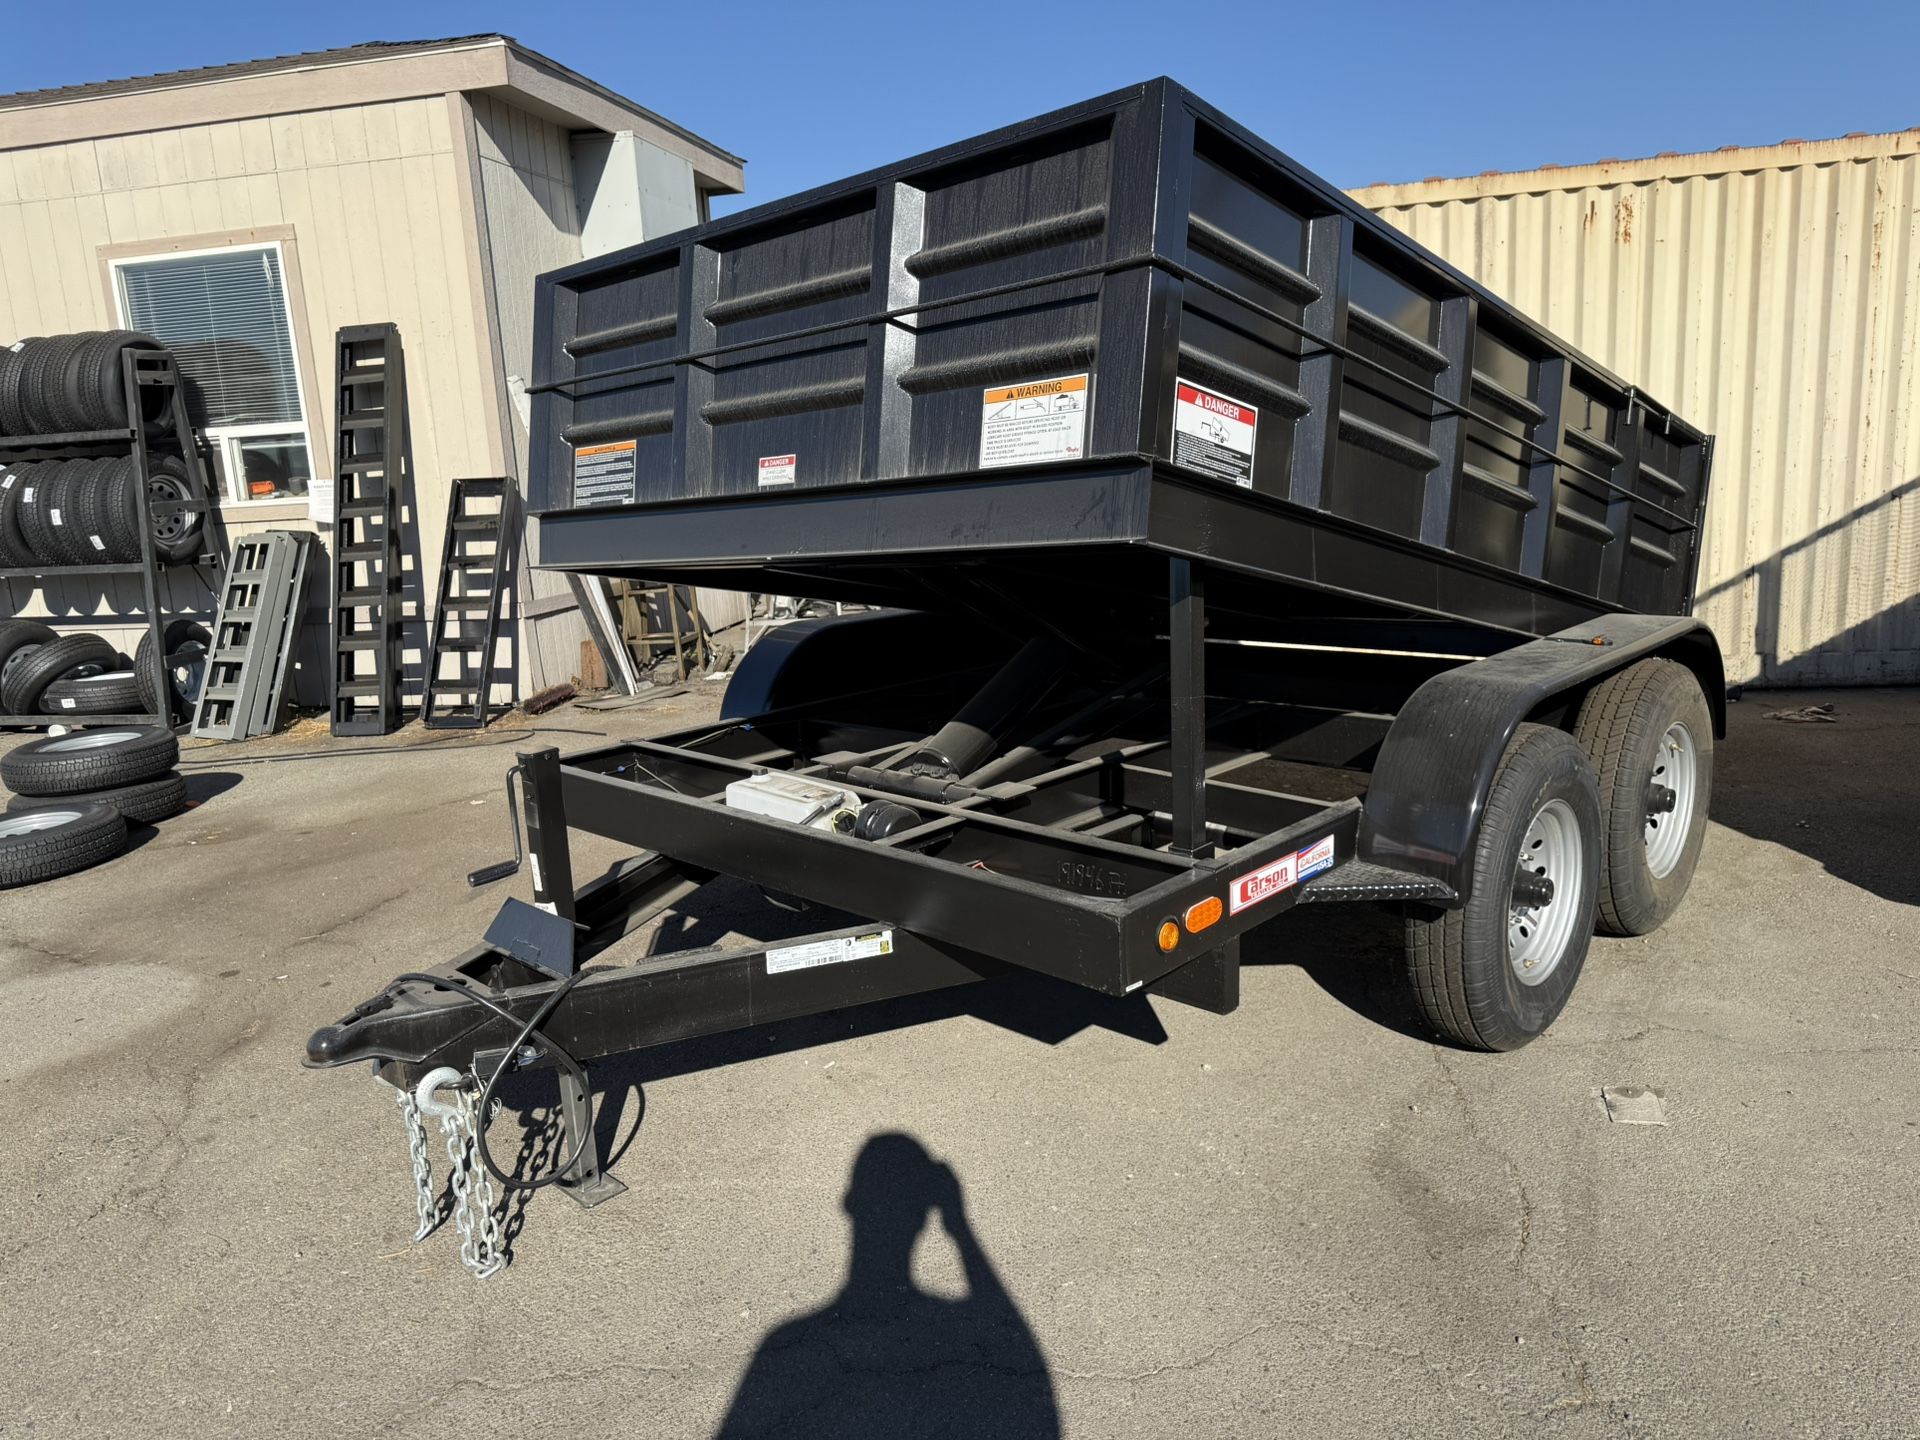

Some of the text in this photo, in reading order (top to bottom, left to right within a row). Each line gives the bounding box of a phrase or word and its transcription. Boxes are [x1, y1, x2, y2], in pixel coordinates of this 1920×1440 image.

[1016, 382, 1062, 398] WARNING
[1205, 397, 1240, 419] DANGER
[1240, 867, 1288, 903] Carson
